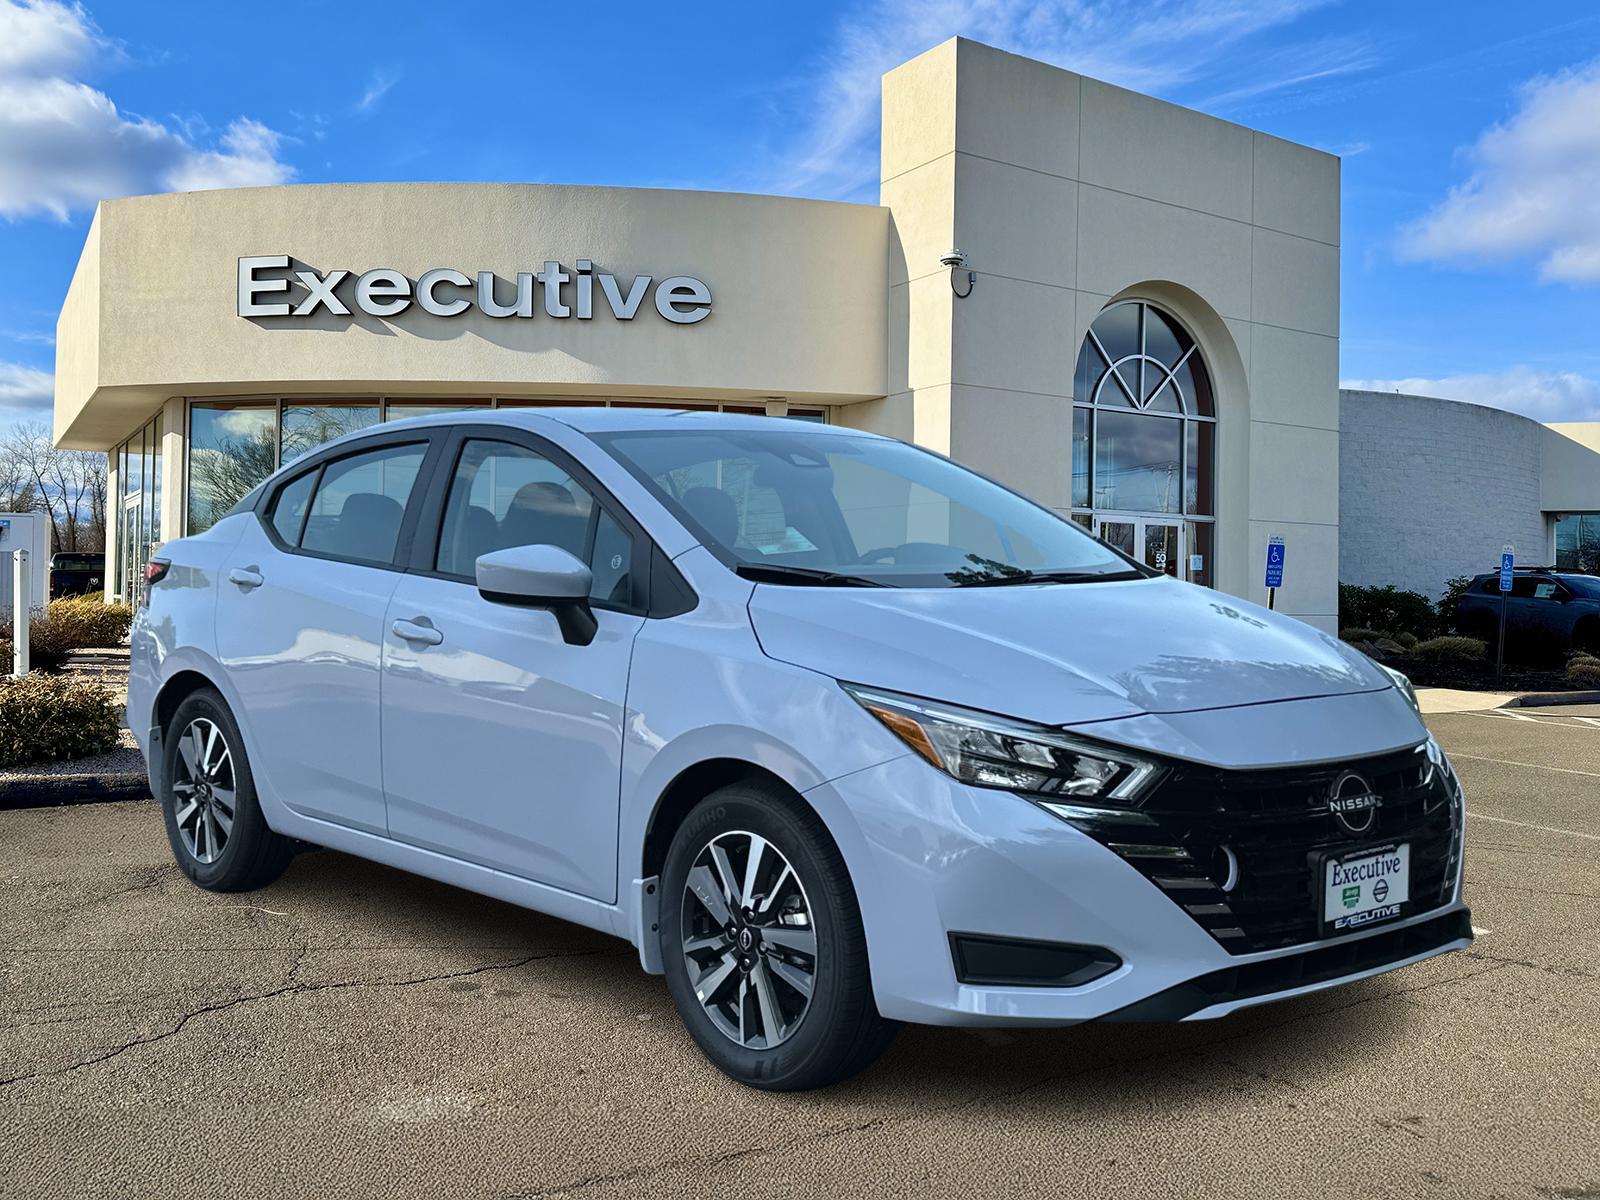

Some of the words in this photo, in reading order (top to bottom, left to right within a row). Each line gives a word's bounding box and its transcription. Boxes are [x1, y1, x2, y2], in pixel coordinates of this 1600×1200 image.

[237, 255, 713, 324] Executive
[1329, 794, 1377, 812] NISSAN
[1332, 855, 1401, 887] Executive
[1334, 904, 1401, 929] EXECUTIVE
